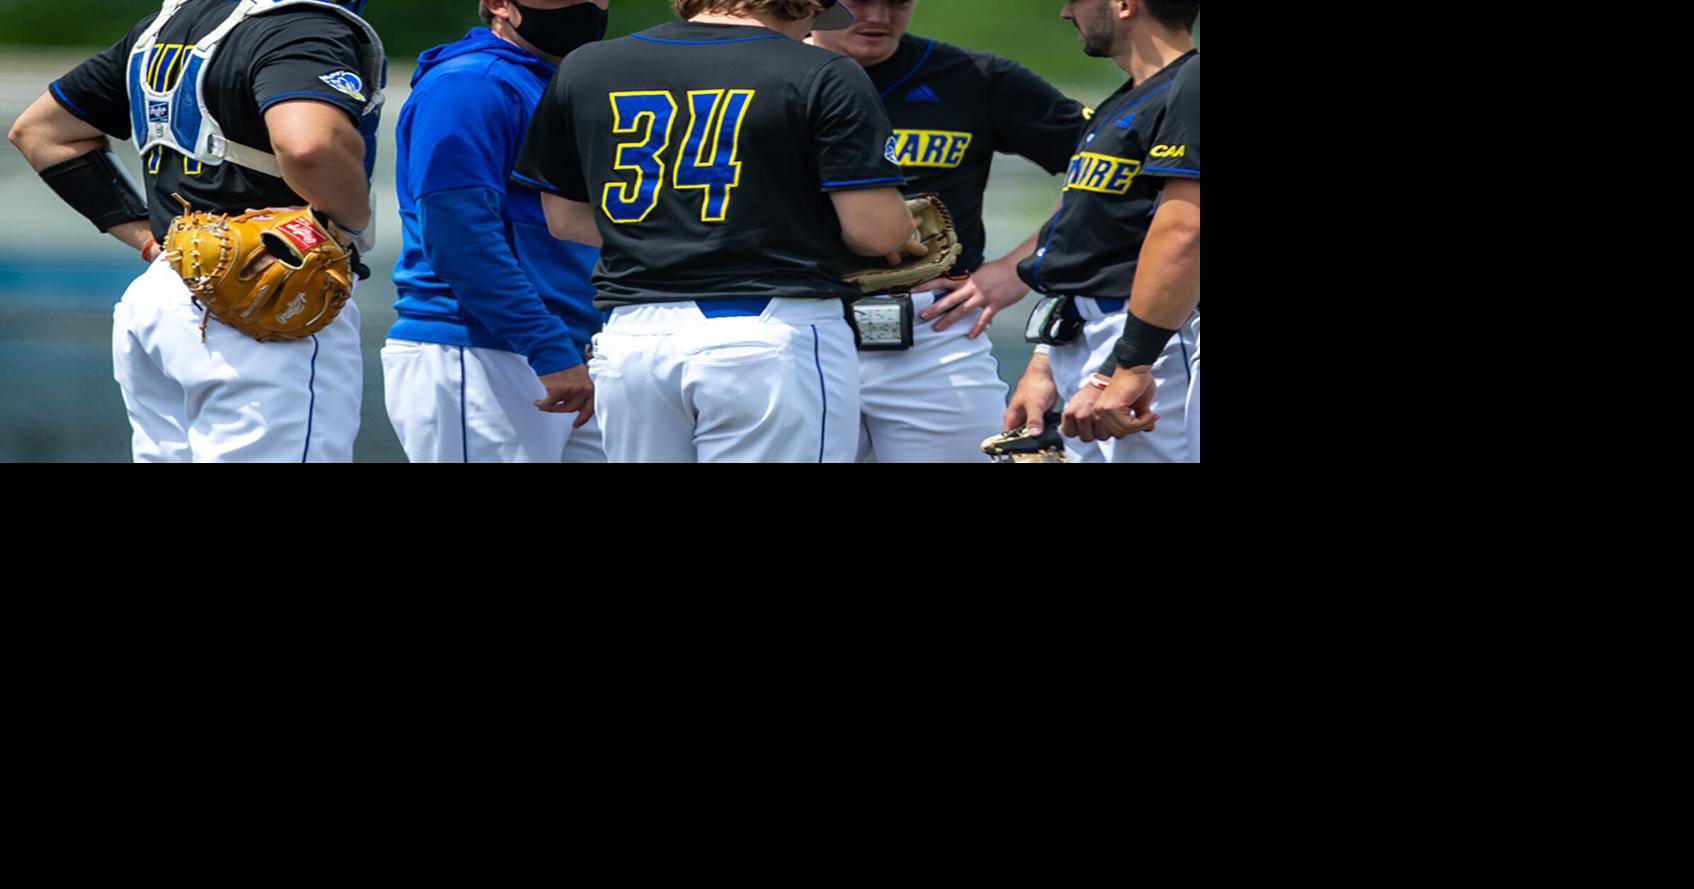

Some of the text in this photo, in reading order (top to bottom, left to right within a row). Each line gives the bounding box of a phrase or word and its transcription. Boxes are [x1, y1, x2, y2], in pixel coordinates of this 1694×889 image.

[601, 88, 756, 223] 34
[893, 130, 971, 167] ARE
[1150, 144, 1185, 157] CAA
